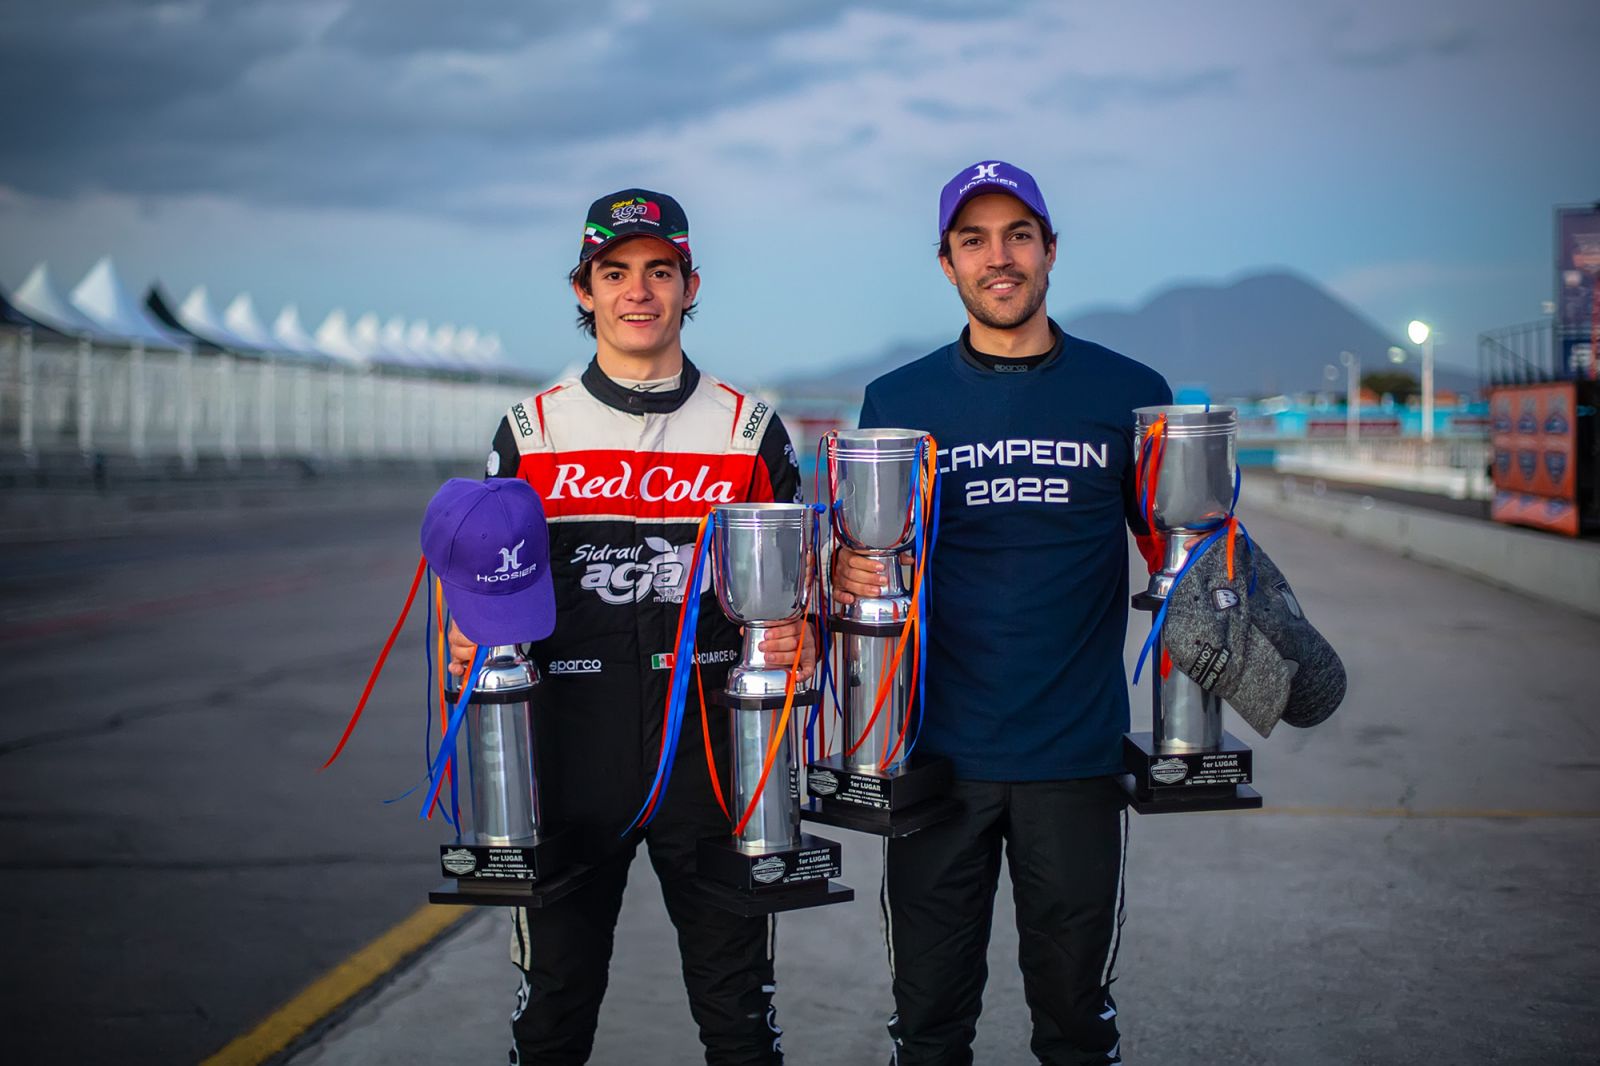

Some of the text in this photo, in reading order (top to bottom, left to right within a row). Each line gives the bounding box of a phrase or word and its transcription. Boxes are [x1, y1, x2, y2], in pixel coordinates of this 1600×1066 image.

[611, 204, 648, 221] aga
[742, 402, 768, 440] sparco
[935, 439, 1108, 474] CAMPEON
[545, 460, 736, 503] Red Cola
[965, 477, 1069, 506] 2022
[476, 563, 537, 583] HOOSIER
[580, 562, 685, 605] aga
[549, 658, 602, 674] sparco
[690, 649, 729, 665] ARCIARCE
[860, 782, 881, 791] LUGAR
[809, 854, 830, 863] LUGAR
